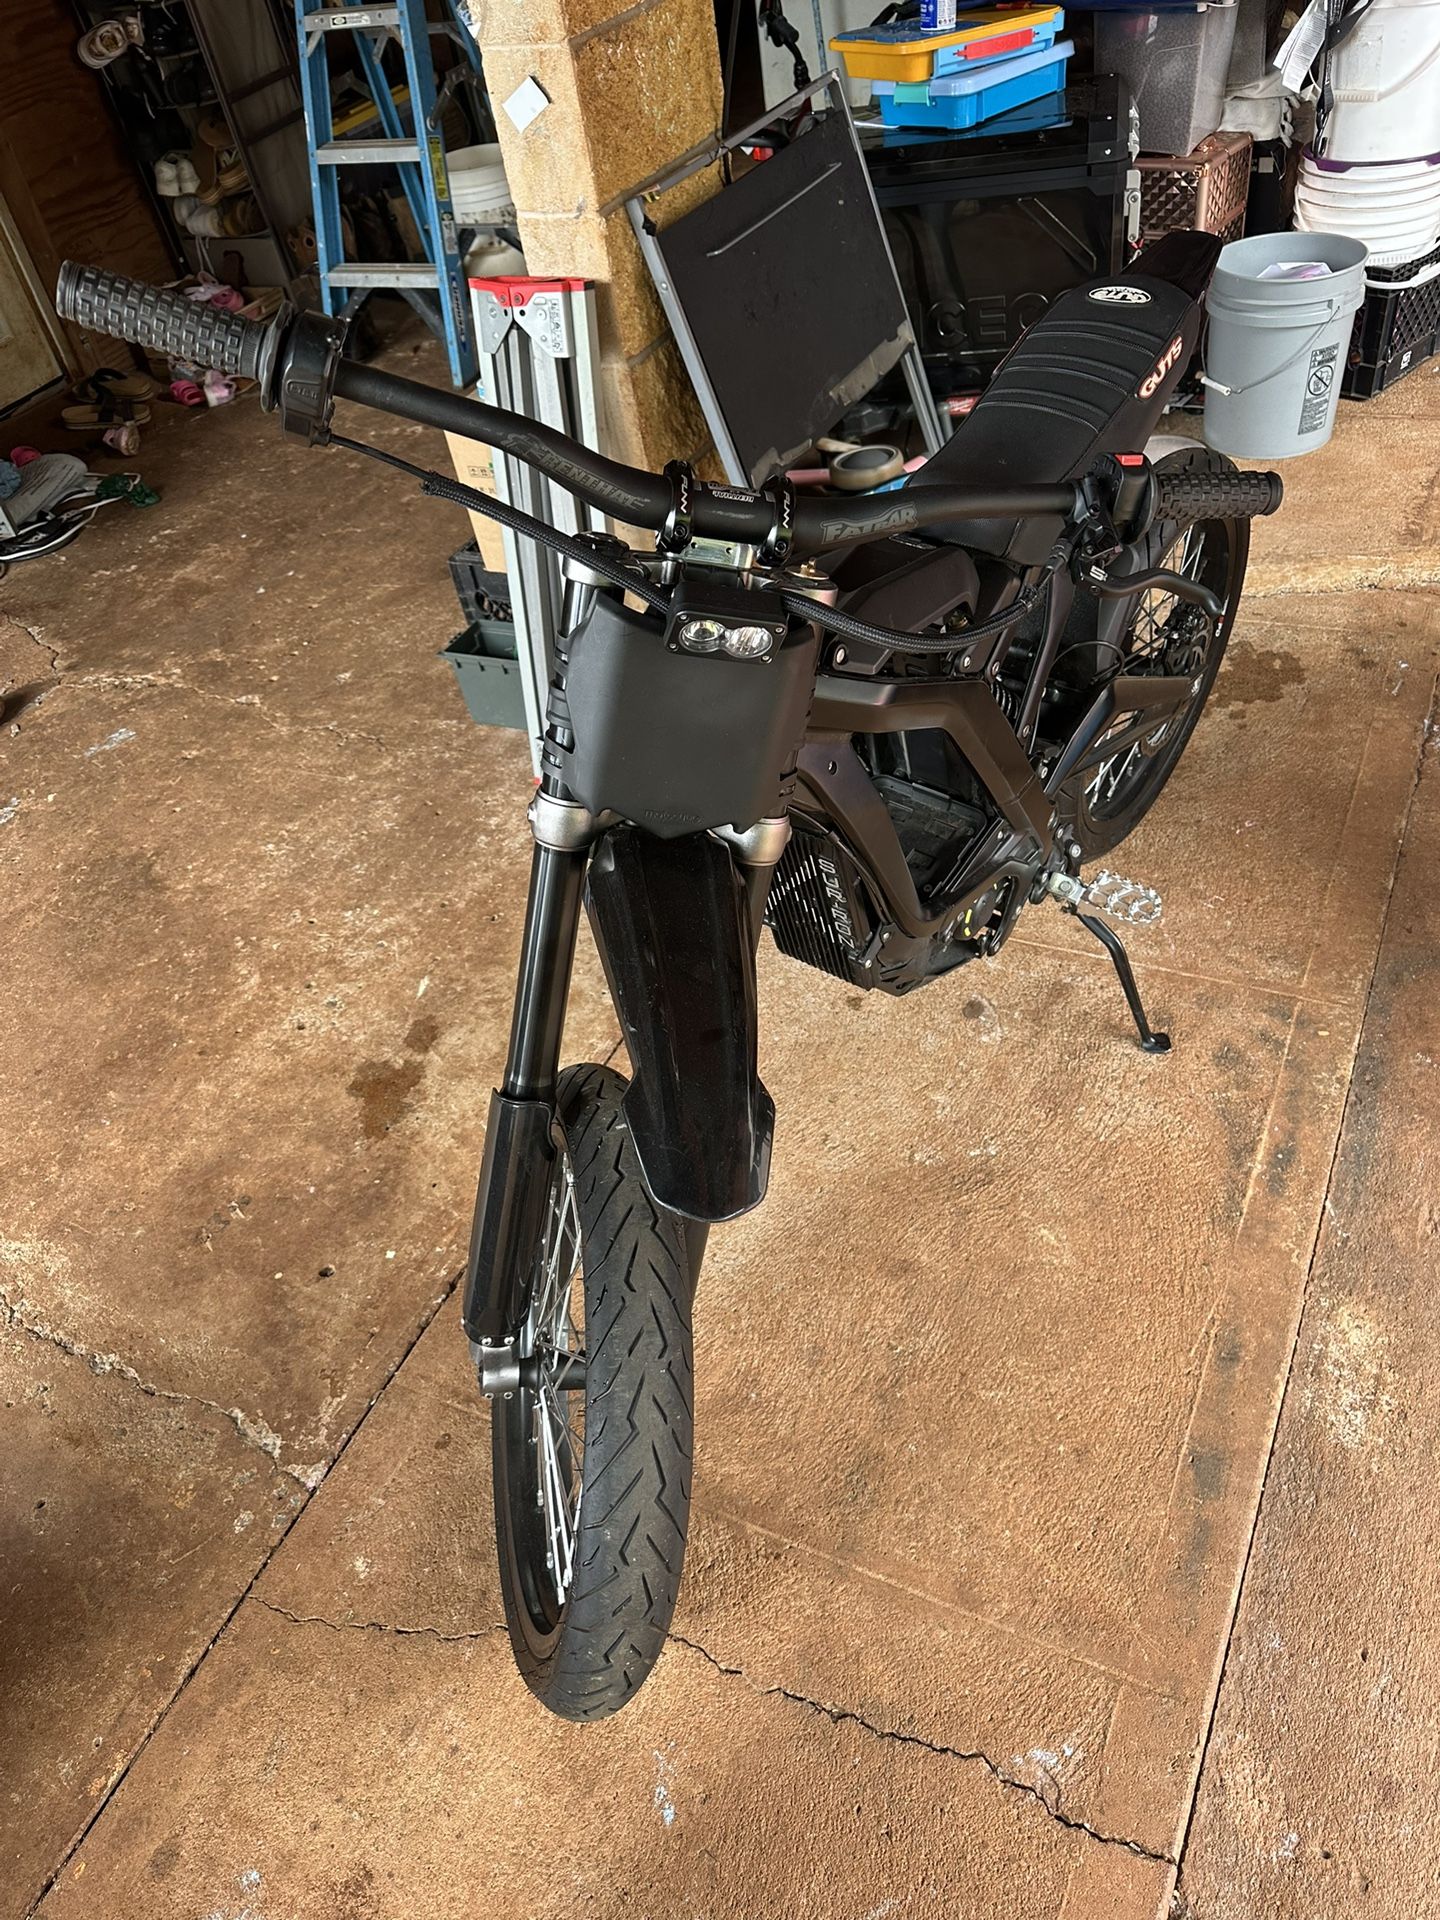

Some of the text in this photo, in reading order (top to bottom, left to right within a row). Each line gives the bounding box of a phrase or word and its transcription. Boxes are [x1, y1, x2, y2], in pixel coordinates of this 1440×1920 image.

[1138, 335, 1183, 399] GUTS
[538, 450, 651, 511] RENTHAL
[680, 473, 689, 514] FUNN
[781, 490, 791, 529] FUNN
